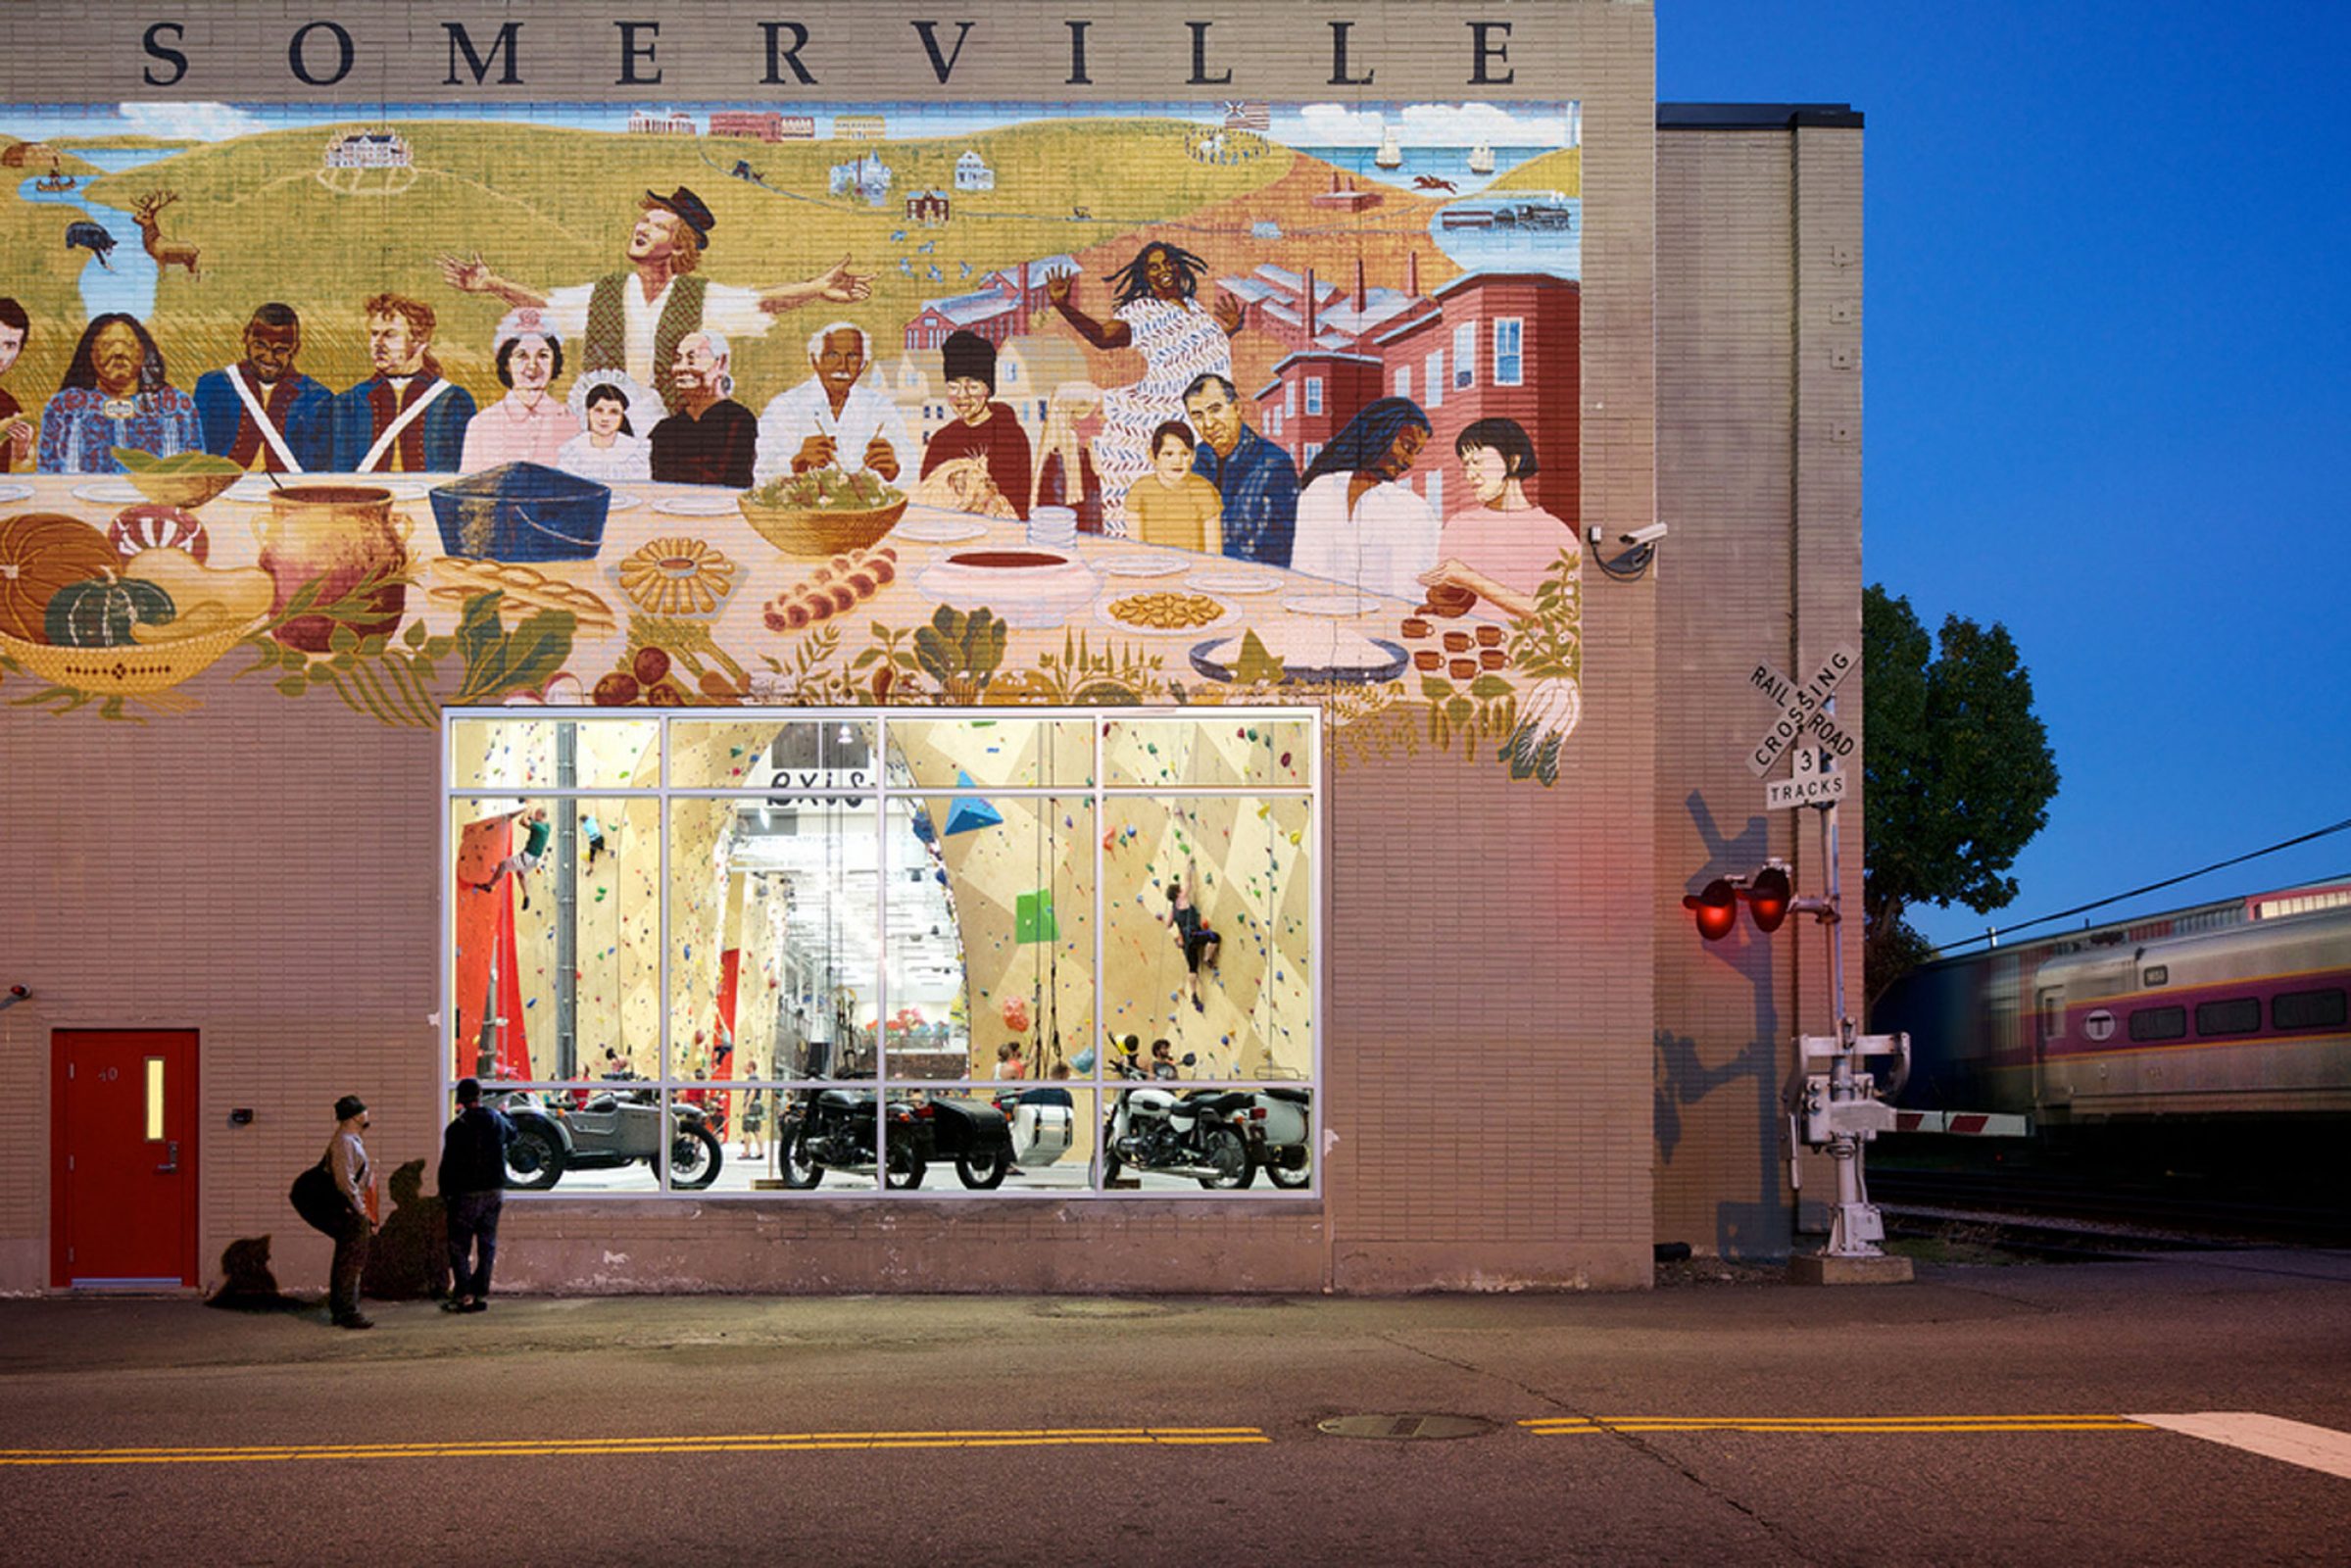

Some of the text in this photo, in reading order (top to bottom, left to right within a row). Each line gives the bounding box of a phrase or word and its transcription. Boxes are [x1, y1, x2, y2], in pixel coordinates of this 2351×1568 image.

[142, 22, 1513, 85] SOMERVILLE
[1750, 665, 1854, 757] RAIL ROAD
[1755, 653, 1849, 766] CROSSING
[1800, 750, 1812, 771] 3
[1771, 778, 1842, 802] TRACKS
[2088, 1013, 2112, 1038] T
